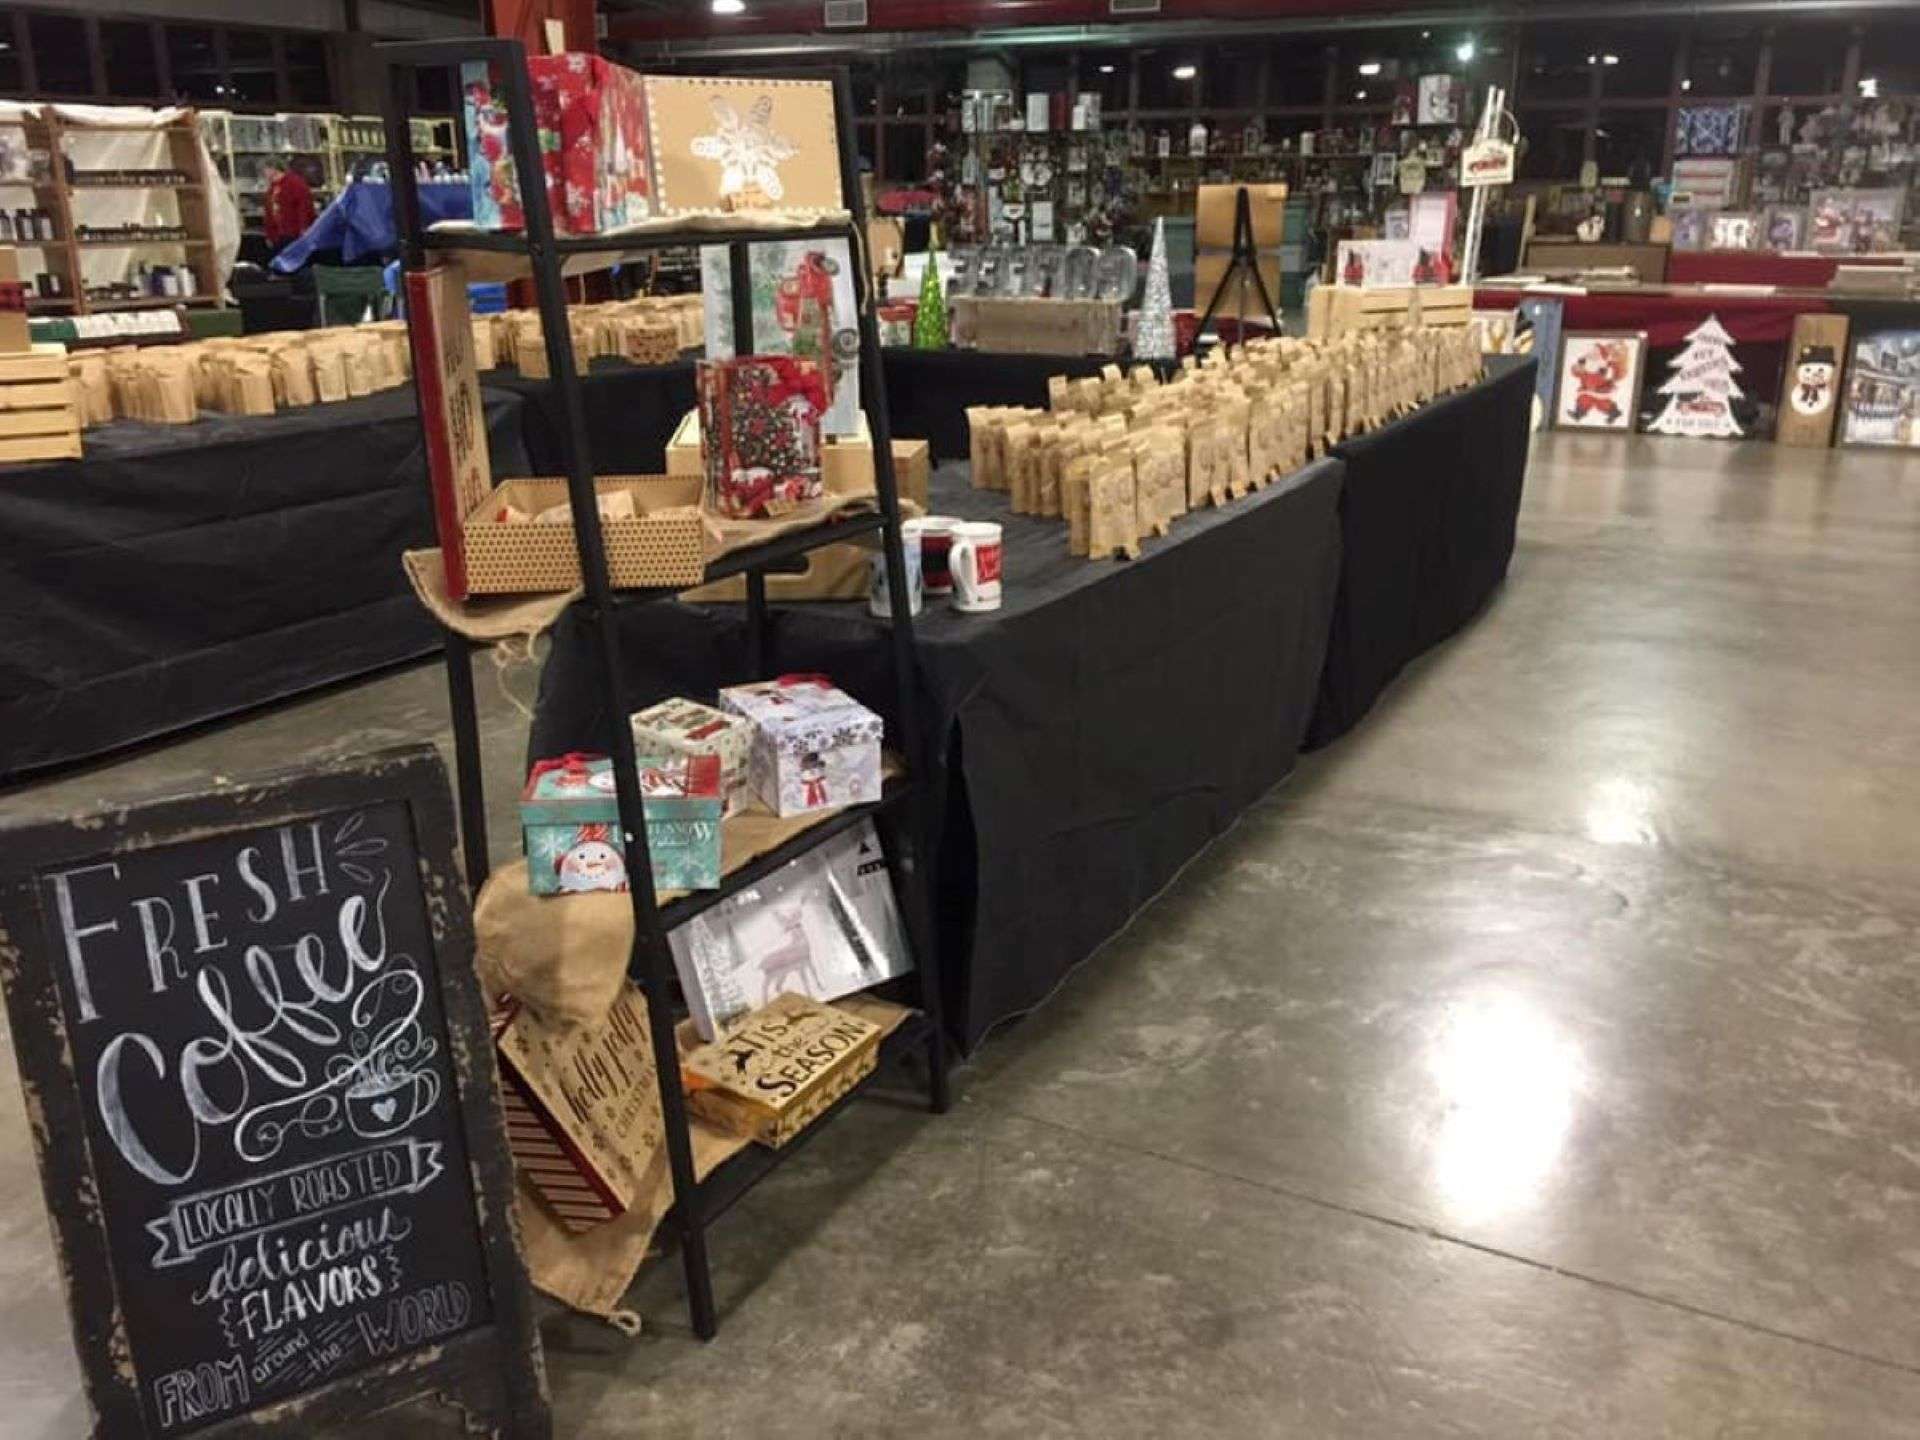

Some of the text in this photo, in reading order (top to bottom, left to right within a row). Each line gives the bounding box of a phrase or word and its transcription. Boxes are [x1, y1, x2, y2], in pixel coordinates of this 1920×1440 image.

[43, 822, 330, 1024] FRESH
[97, 868, 391, 1184] Coffee
[755, 1021, 867, 1098] SEASON
[182, 1150, 400, 1244] LOCALLY ROASTED
[193, 1207, 412, 1304] delicious
[239, 1254, 381, 1339] FLAVORS
[153, 1283, 471, 1428] FROM around the WORLD
